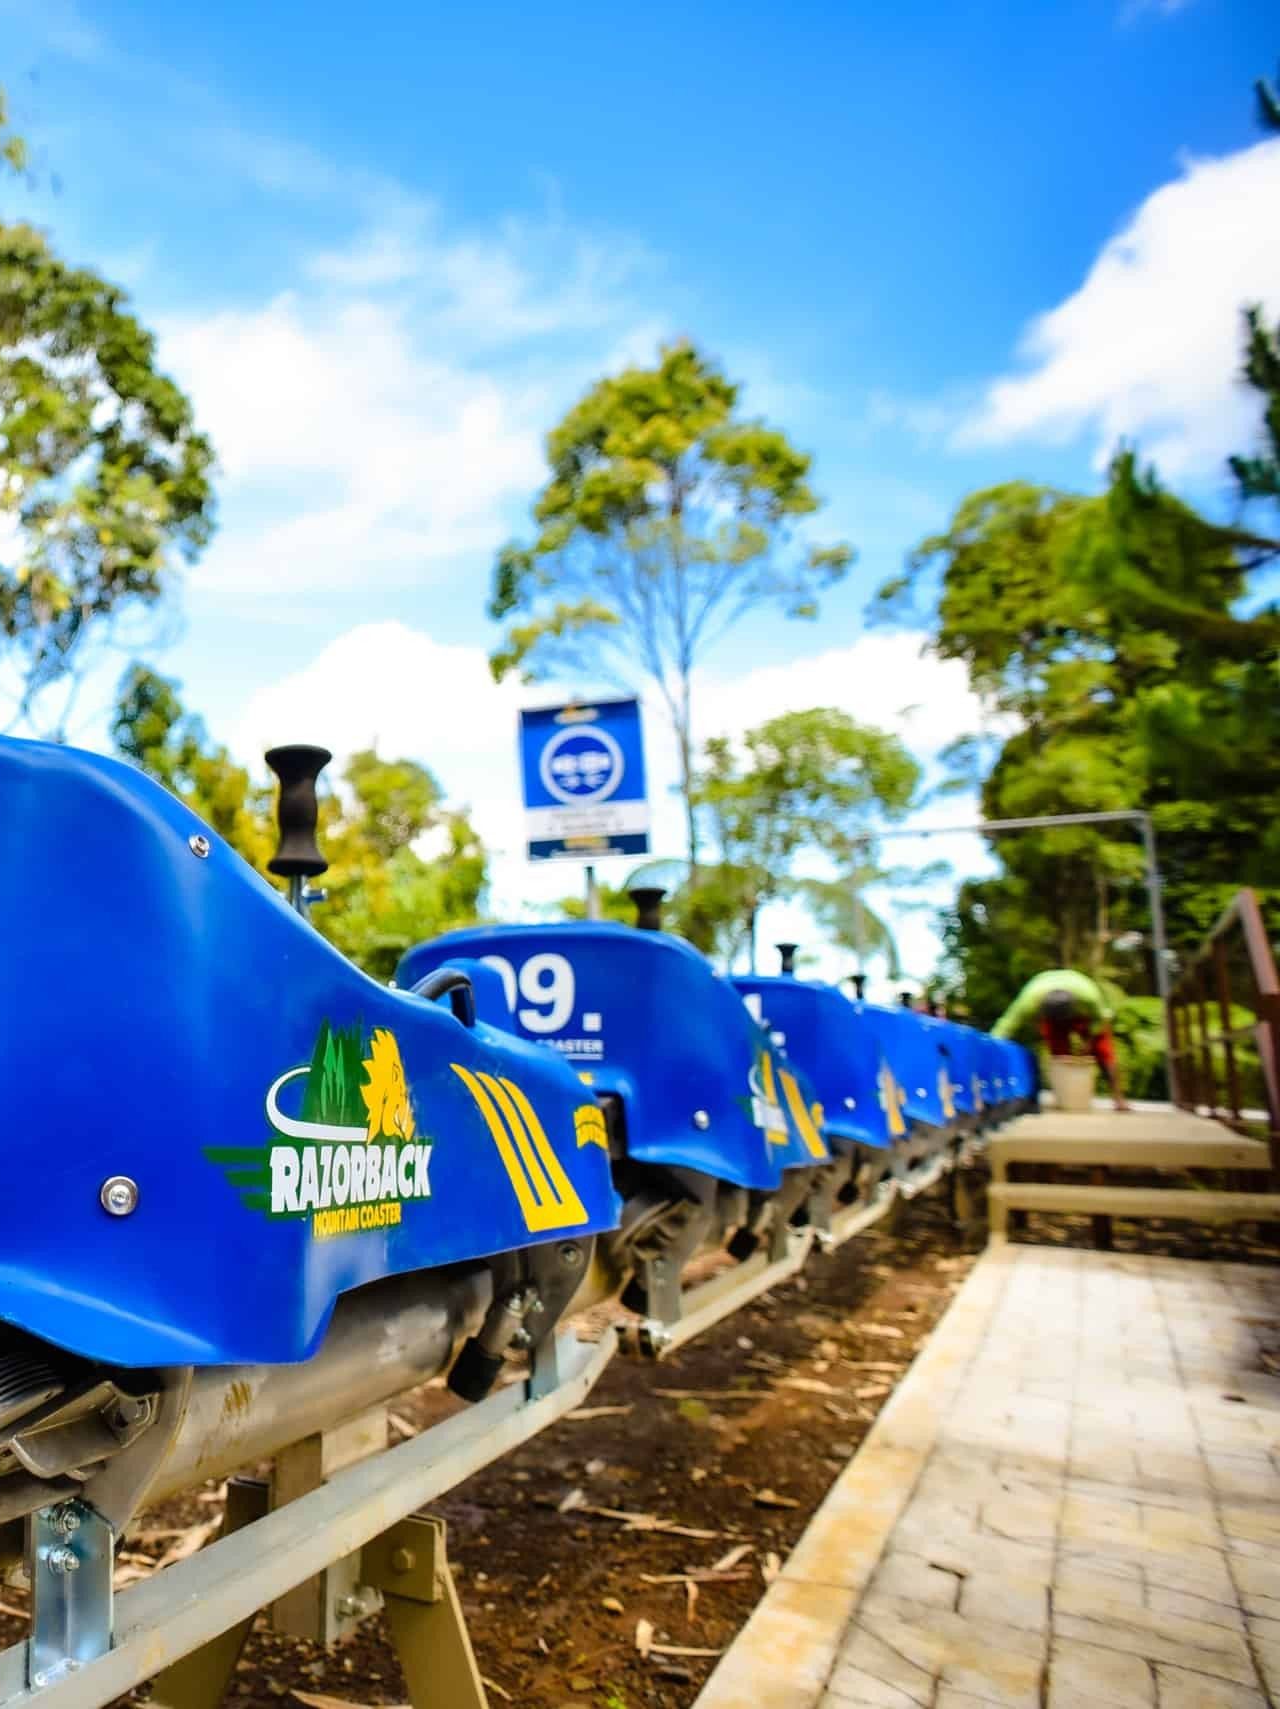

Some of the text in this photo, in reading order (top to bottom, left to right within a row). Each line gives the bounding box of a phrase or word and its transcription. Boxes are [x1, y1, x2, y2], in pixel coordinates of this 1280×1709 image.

[270, 1144, 432, 1213] RAZORBACK
[314, 1202, 402, 1237] MOUNTAIN COASTER
